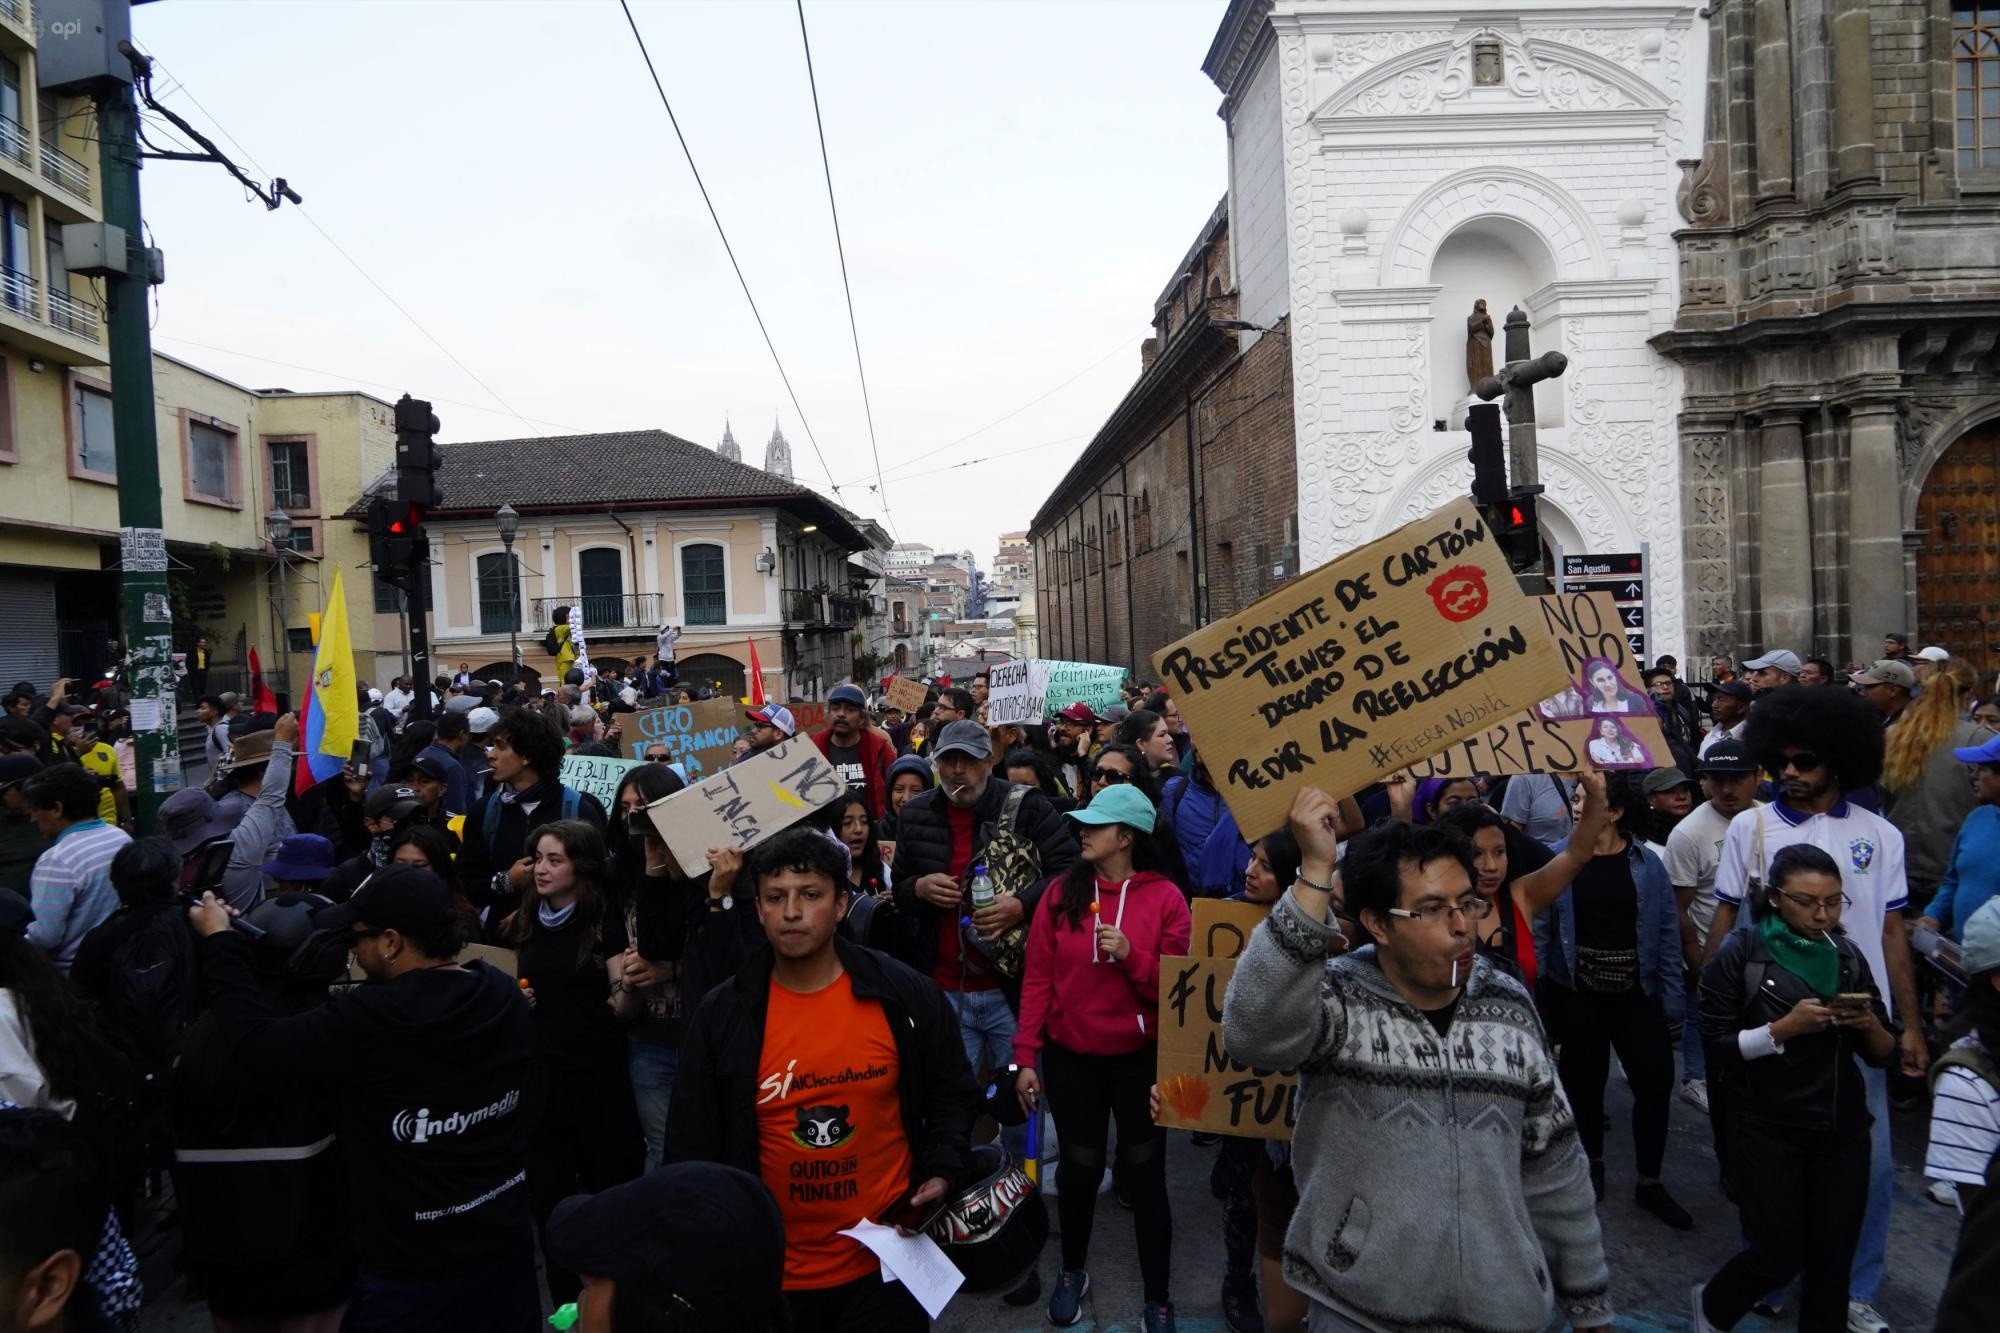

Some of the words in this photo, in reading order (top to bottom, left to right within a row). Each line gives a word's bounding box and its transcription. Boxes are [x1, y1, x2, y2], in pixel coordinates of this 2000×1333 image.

[1567, 565, 1582, 574] San
[1583, 563, 1611, 576] Agustín
[1161, 597, 1331, 694] PRESIDENTE
[1334, 572, 1377, 612] DE
[1382, 517, 1485, 587] CARTÓN
[1539, 592, 1601, 638] NO
[1242, 638, 1346, 688] TIENES
[1354, 615, 1399, 645] EL
[1353, 641, 1411, 680] DE
[1558, 632, 1624, 674] NO
[990, 662, 1028, 688] DERECHA
[1066, 683, 1114, 697] MUJERES
[638, 706, 693, 737] CERO
[1228, 741, 1316, 790] PEDIR
[1319, 717, 1367, 752] LA
[1352, 625, 1527, 722] REELECCIÓN
[1392, 720, 1578, 781] UJERES
[411, 1090, 520, 1143] indymedia
[789, 1160, 839, 1180] QUITO
